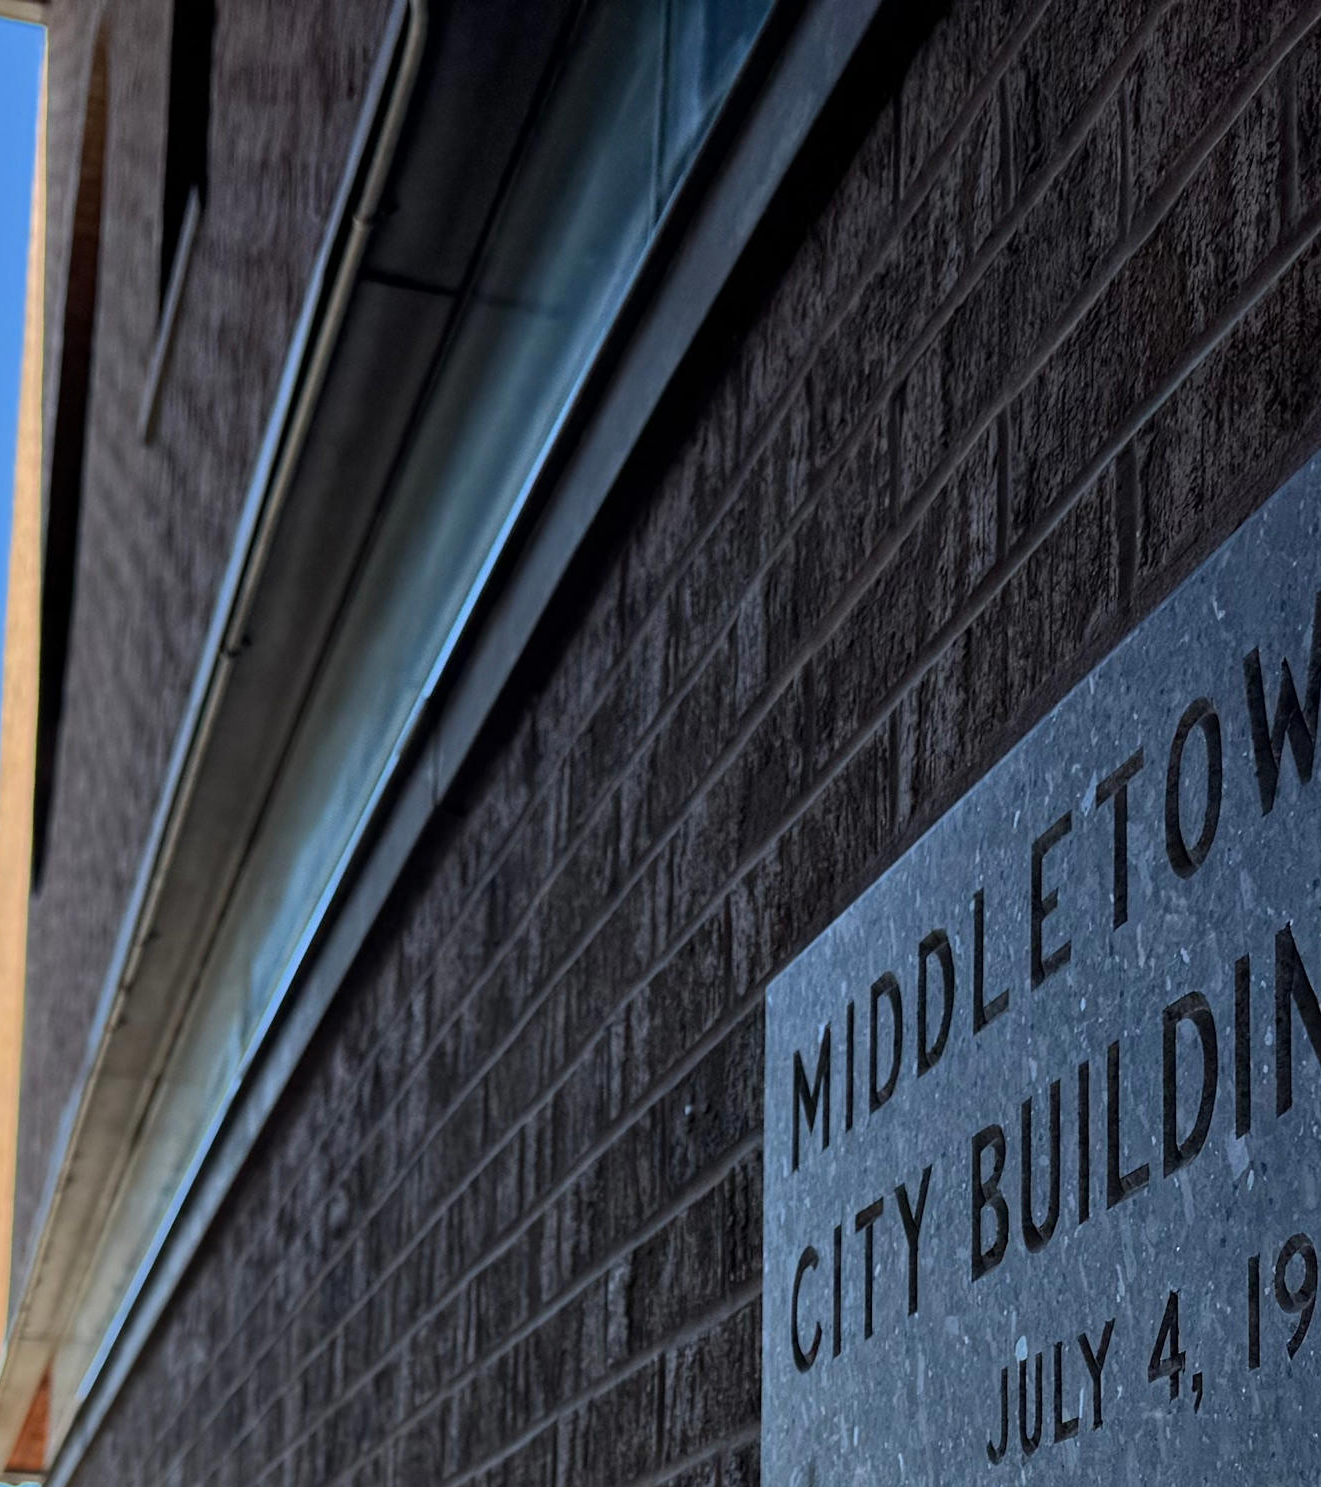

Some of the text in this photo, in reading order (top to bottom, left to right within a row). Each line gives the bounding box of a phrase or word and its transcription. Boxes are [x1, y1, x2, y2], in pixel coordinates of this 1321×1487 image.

[789, 1165, 932, 1374] CITY
[985, 1317, 1117, 1467] JULY
[1146, 1290, 1206, 1415] 4,
